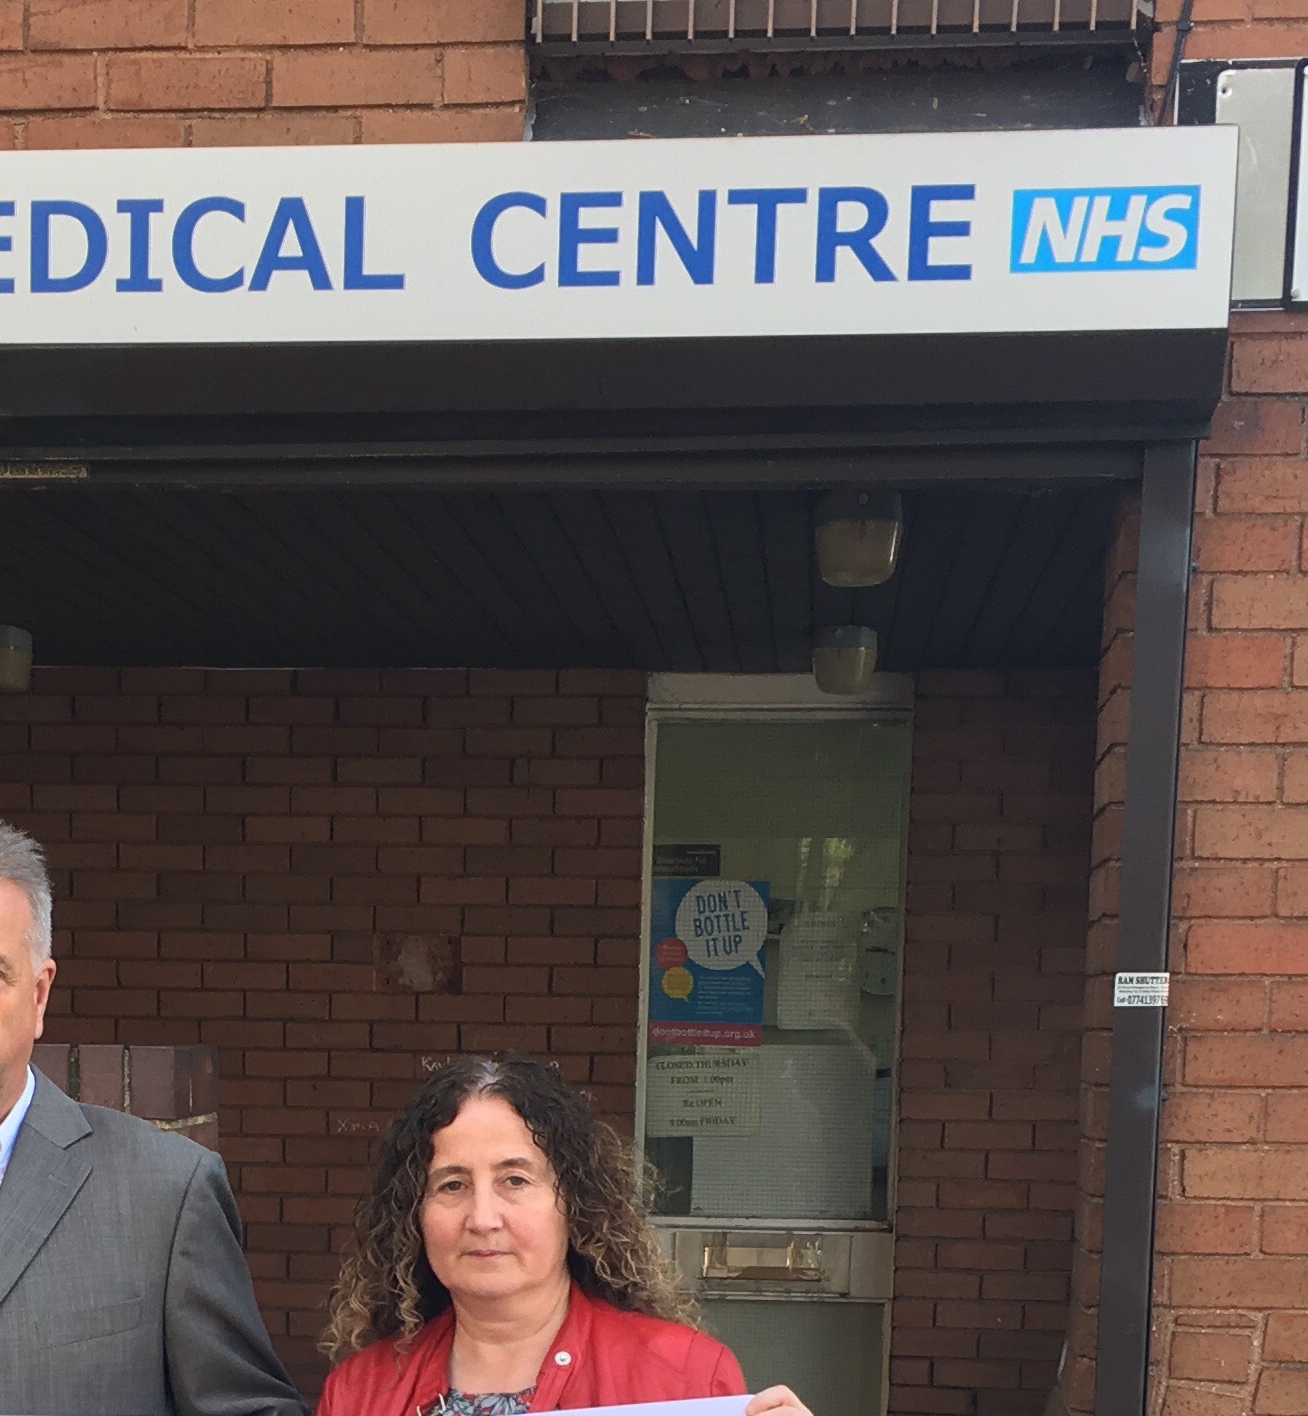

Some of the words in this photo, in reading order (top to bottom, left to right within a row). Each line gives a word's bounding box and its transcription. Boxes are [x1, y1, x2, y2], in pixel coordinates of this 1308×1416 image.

[470, 183, 977, 291] CENTRE
[1019, 193, 1192, 264] NHS
[695, 889, 741, 915] DON'T
[693, 911, 749, 938] BOTTLE
[705, 938, 718, 958] IT
[722, 934, 742, 955] UP
[696, 1058, 747, 1069] THURSDAY
